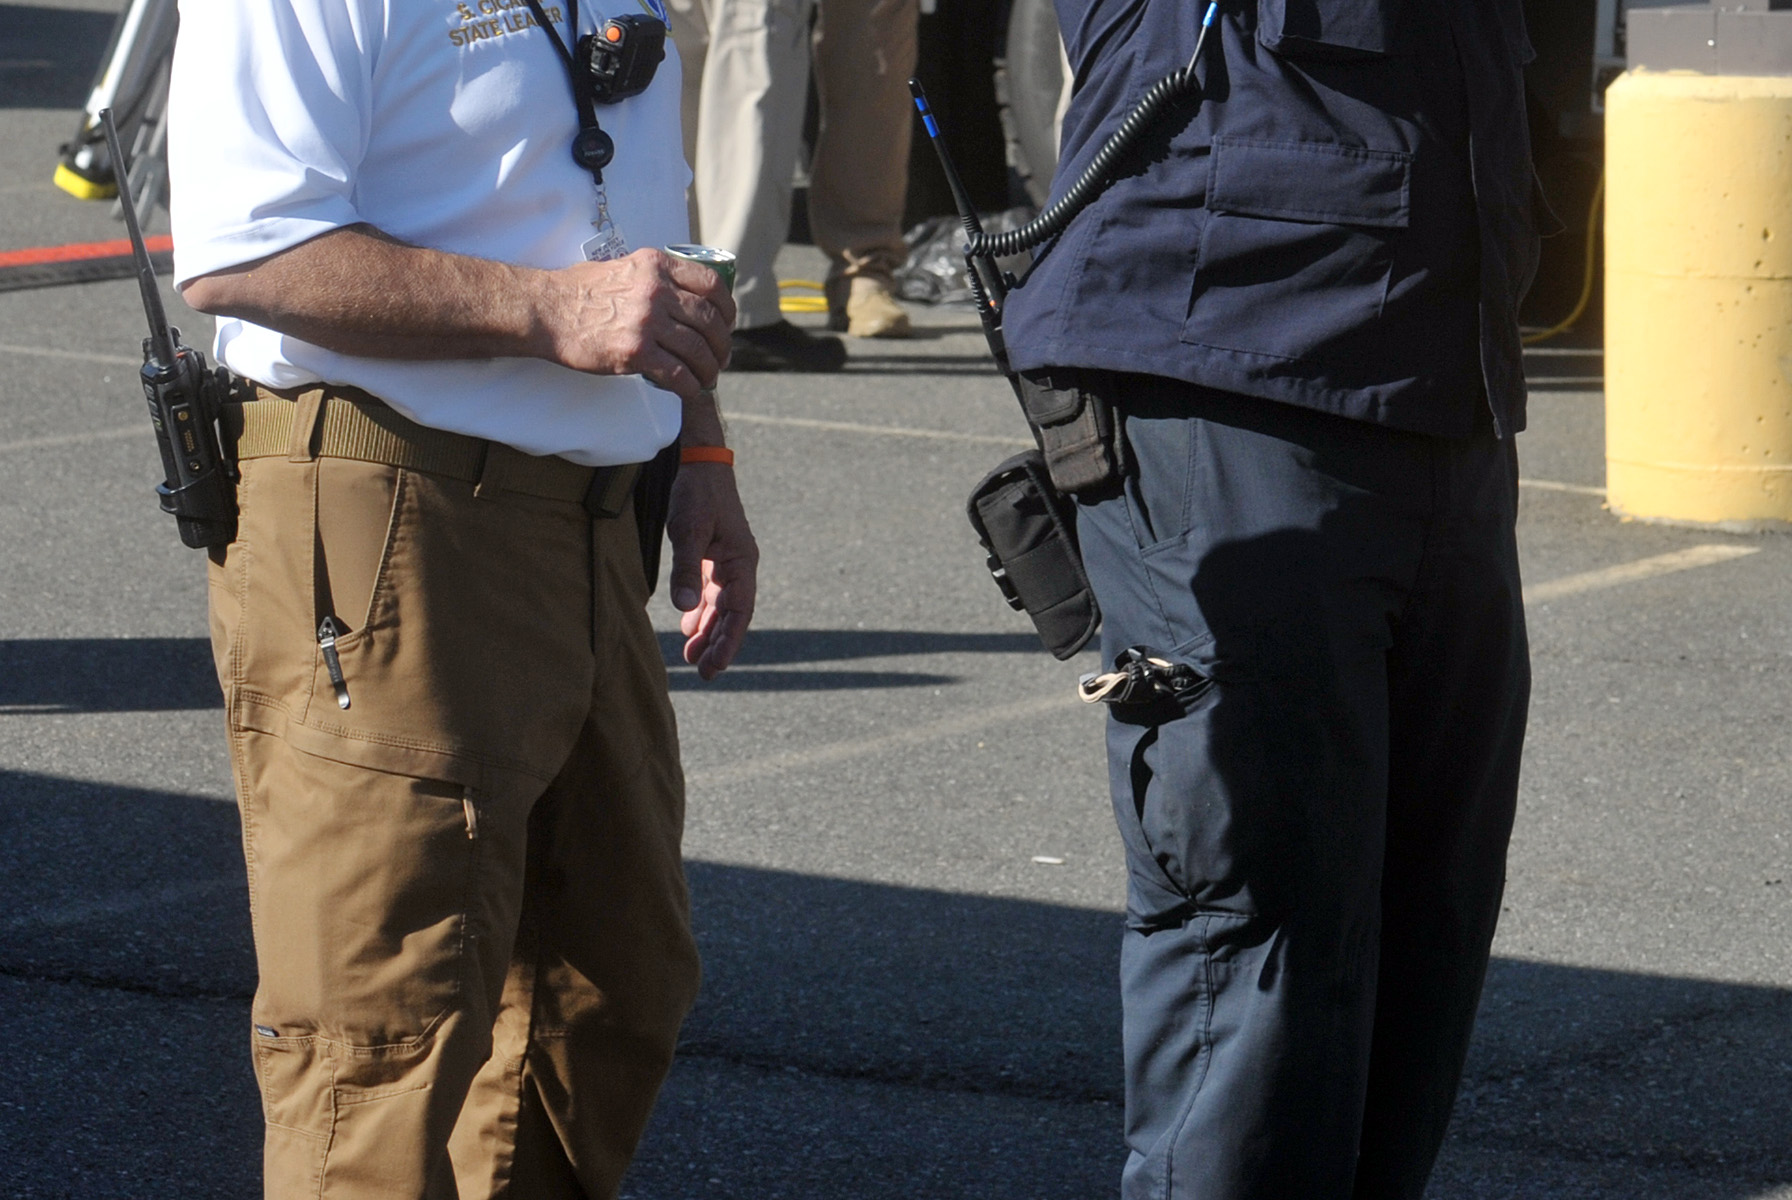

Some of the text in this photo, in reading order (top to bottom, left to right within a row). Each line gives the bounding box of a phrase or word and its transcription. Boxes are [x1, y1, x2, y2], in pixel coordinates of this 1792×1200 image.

[448, 5, 564, 47] STATE LEAER
[456, 1, 477, 21] S.
